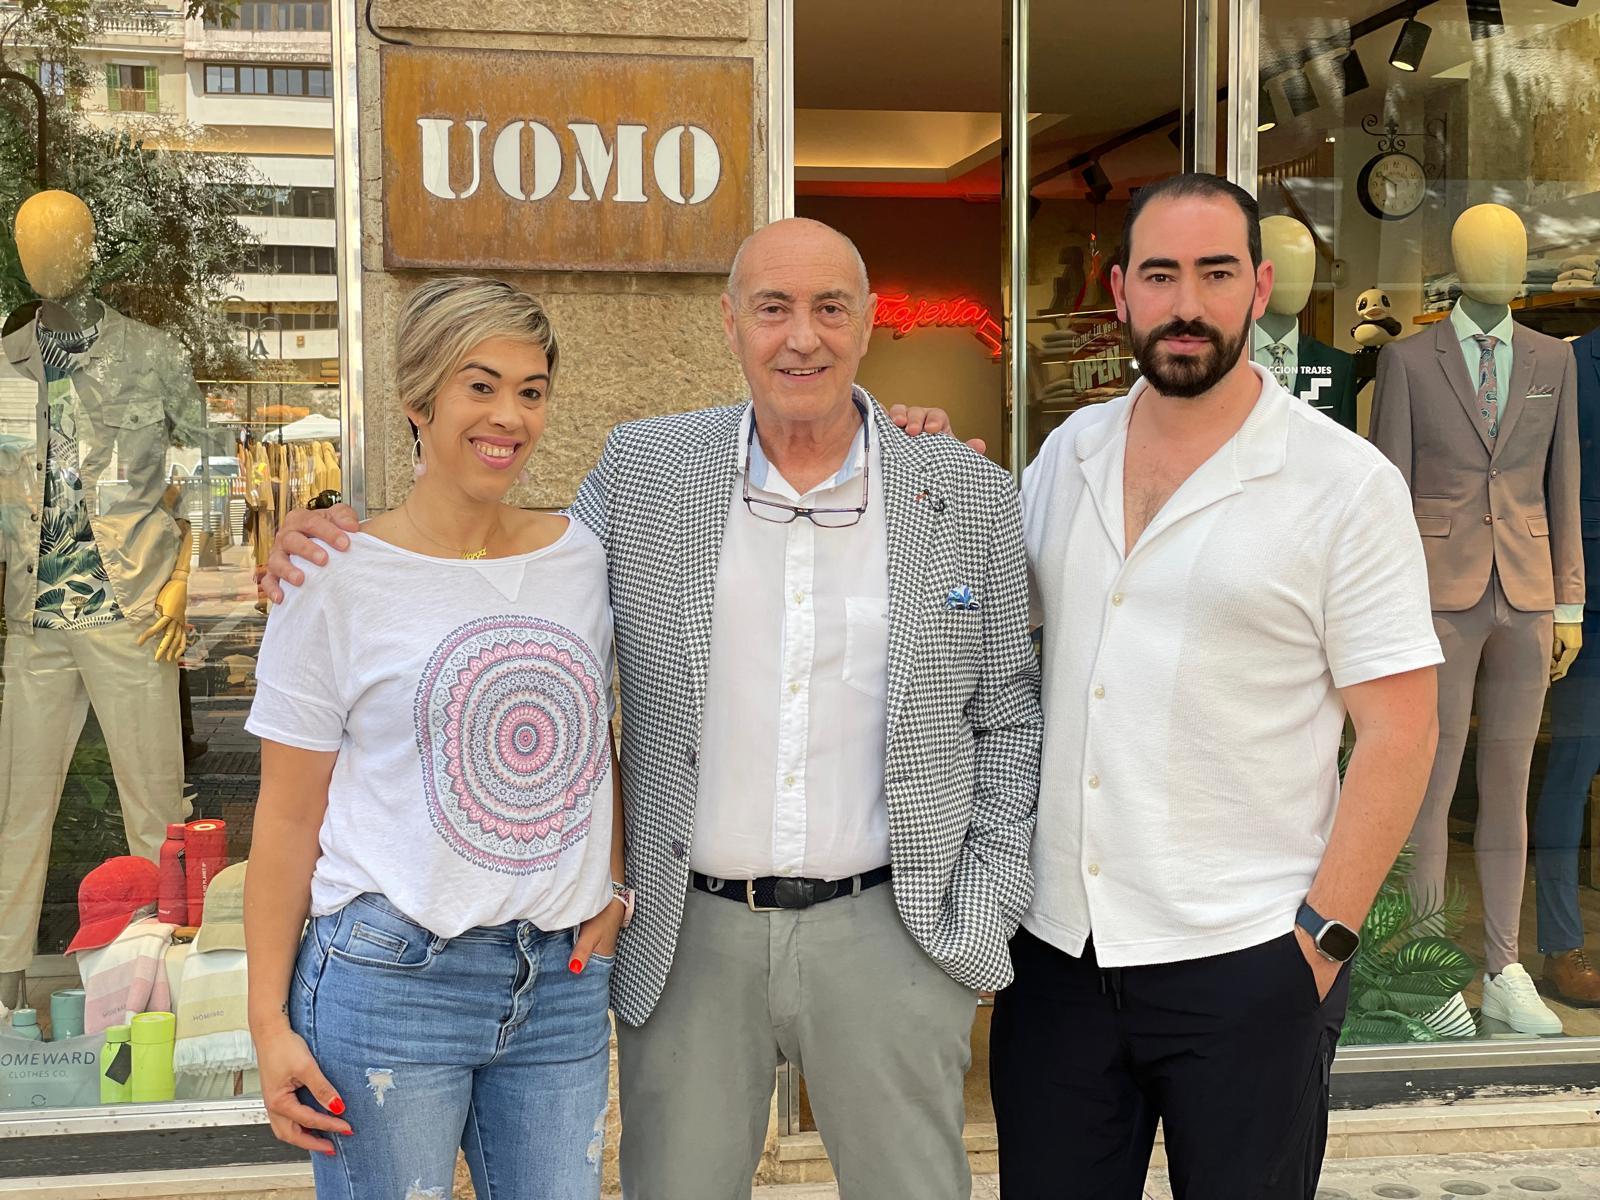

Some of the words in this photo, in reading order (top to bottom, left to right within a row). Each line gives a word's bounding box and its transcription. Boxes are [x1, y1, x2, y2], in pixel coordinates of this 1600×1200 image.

[416, 118, 721, 205] UOMO
[1073, 345, 1122, 393] OPEN
[1300, 366, 1332, 375] TRAJES
[8, 1070, 49, 1079] CLOTHES
